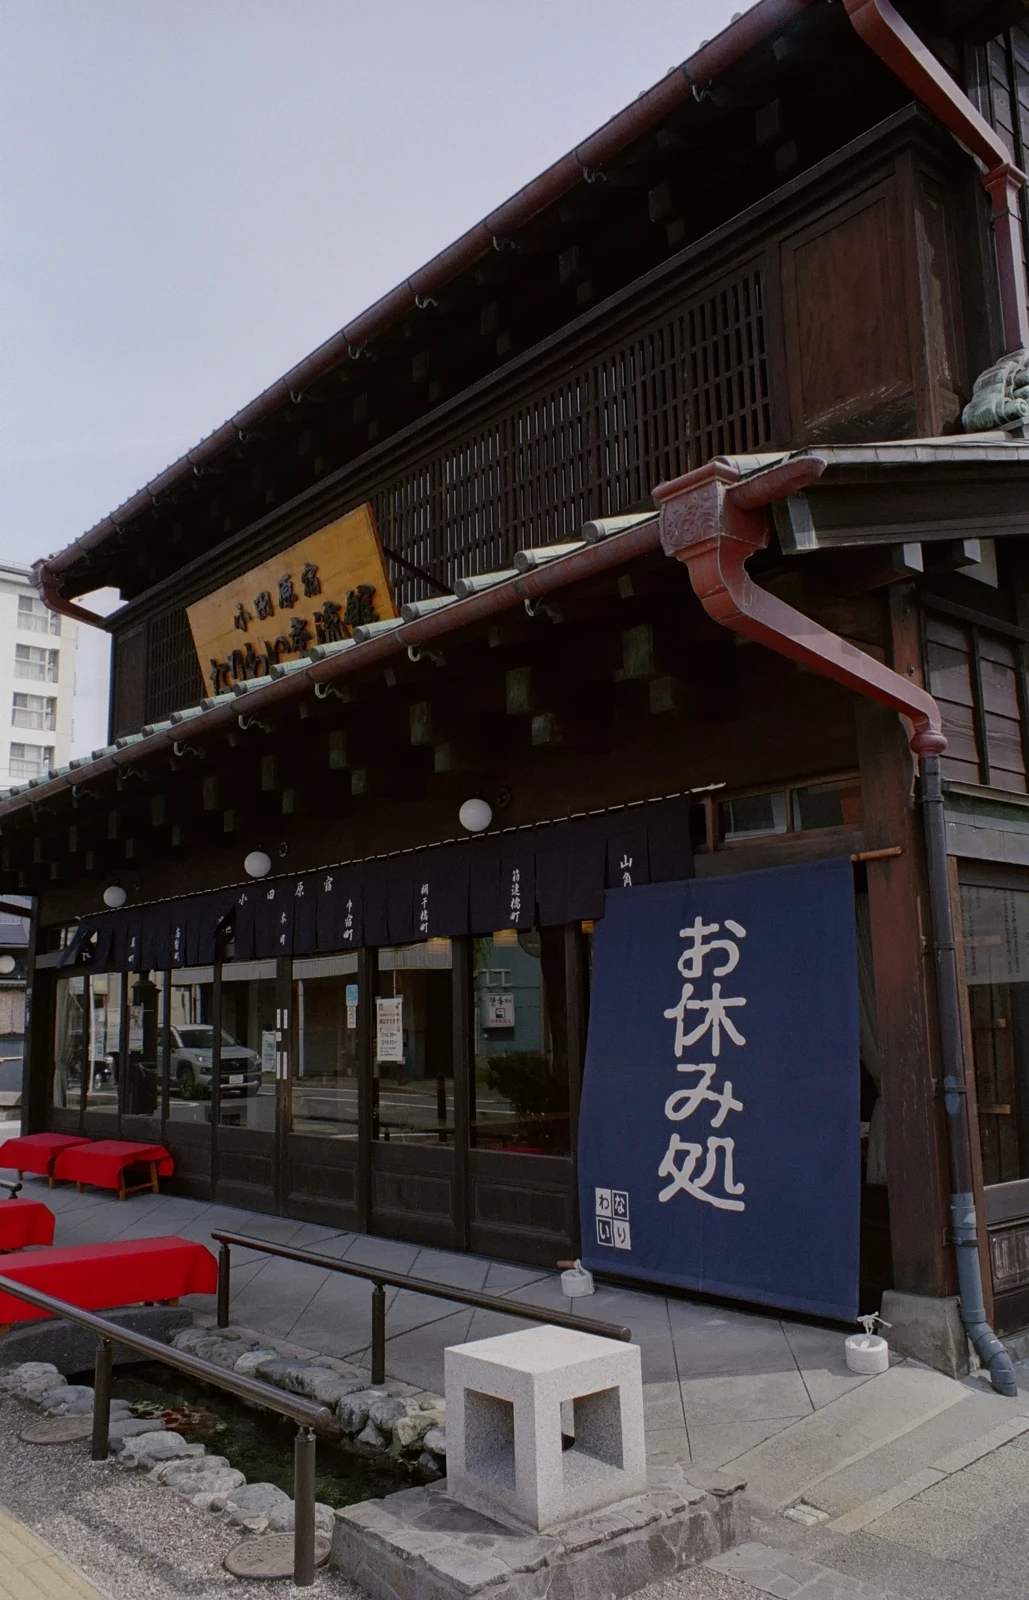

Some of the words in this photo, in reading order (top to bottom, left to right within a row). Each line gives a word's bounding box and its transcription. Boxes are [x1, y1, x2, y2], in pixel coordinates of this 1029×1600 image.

[233, 562, 322, 632] 小田原宿
[658, 915, 746, 1212] お休み処
